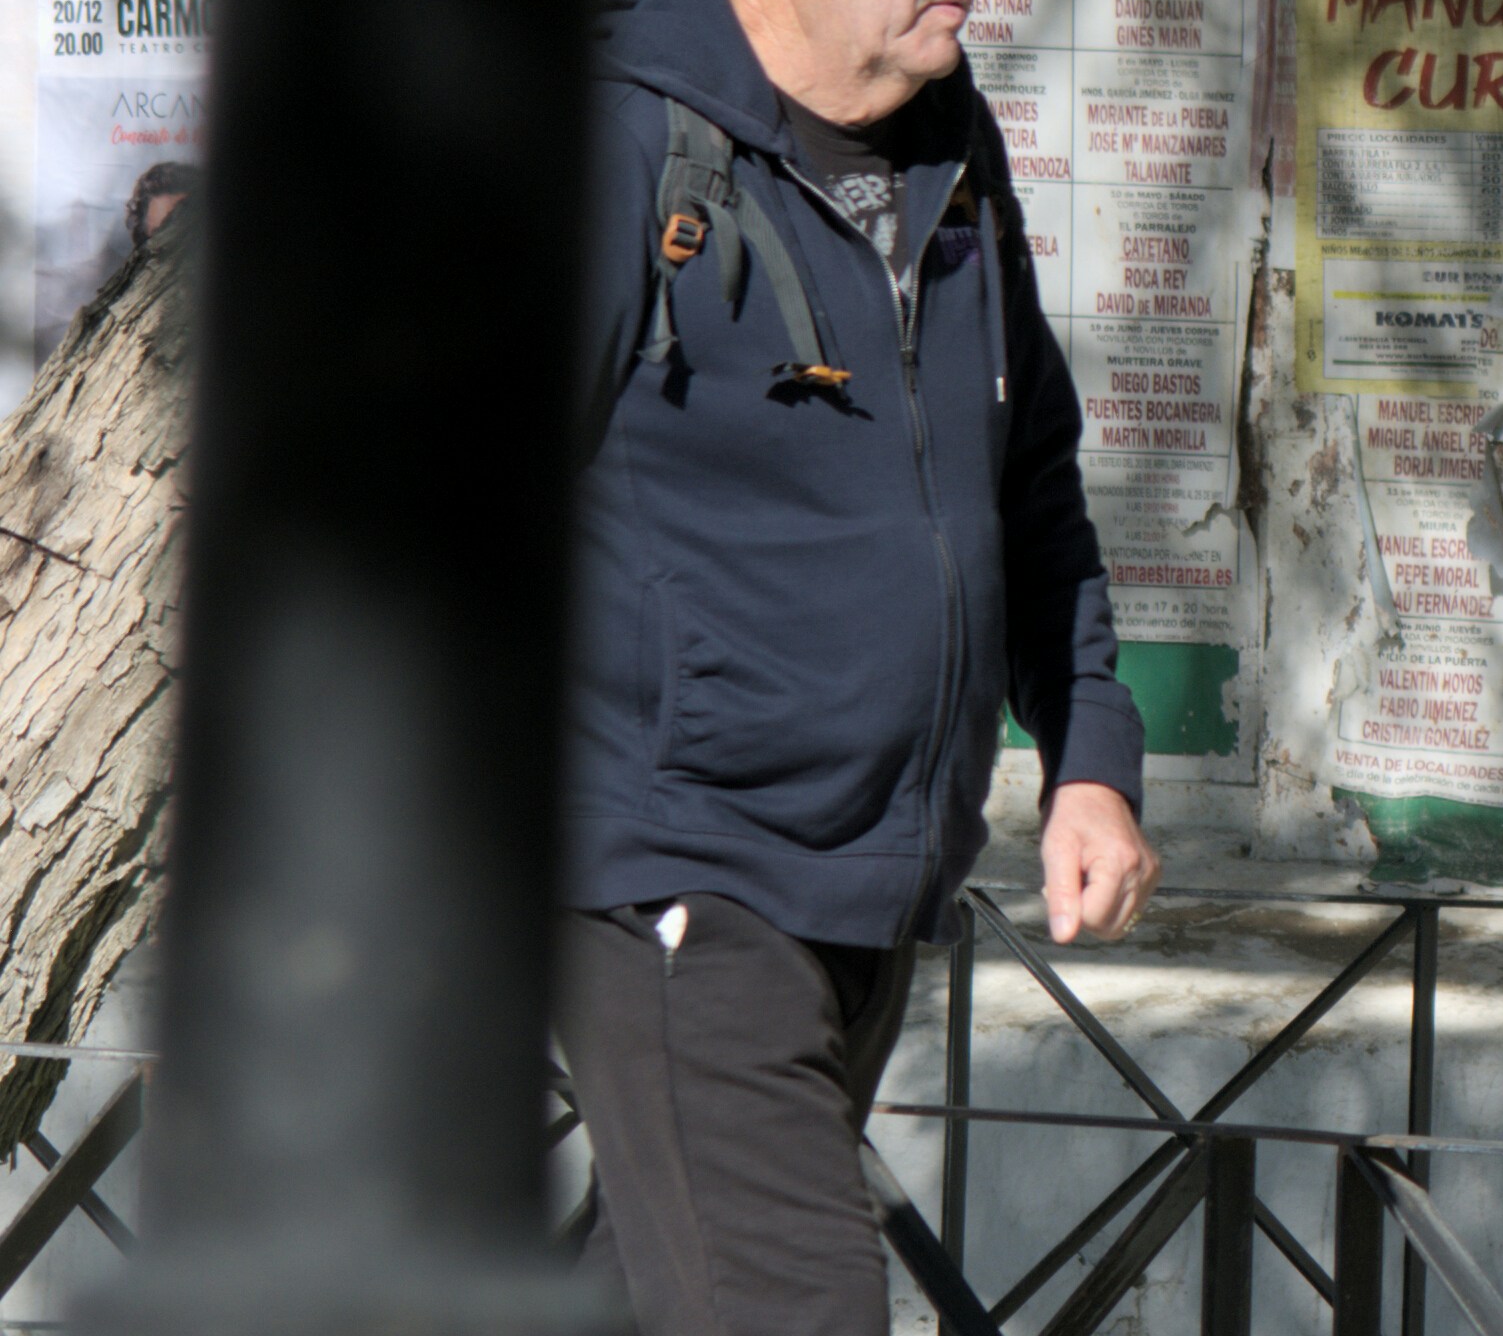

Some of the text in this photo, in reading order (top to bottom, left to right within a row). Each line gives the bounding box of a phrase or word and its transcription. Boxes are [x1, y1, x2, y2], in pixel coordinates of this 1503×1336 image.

[1088, 104, 1229, 130] MORANTE DE LA PUEBLA
[1125, 161, 1191, 183] TALAVANTE
[1123, 237, 1190, 260] CAYETANO
[1125, 268, 1188, 291] ROCA REY
[1112, 372, 1201, 396] DIEGO BASTOS
[1086, 398, 1222, 424] FUENTES BOCANEGRA
[1102, 422, 1207, 451] MARTÍN MORILLA
[1112, 561, 1233, 586] lamaestranza.es
[1379, 665, 1484, 695] VALENTÍN HOYOS
